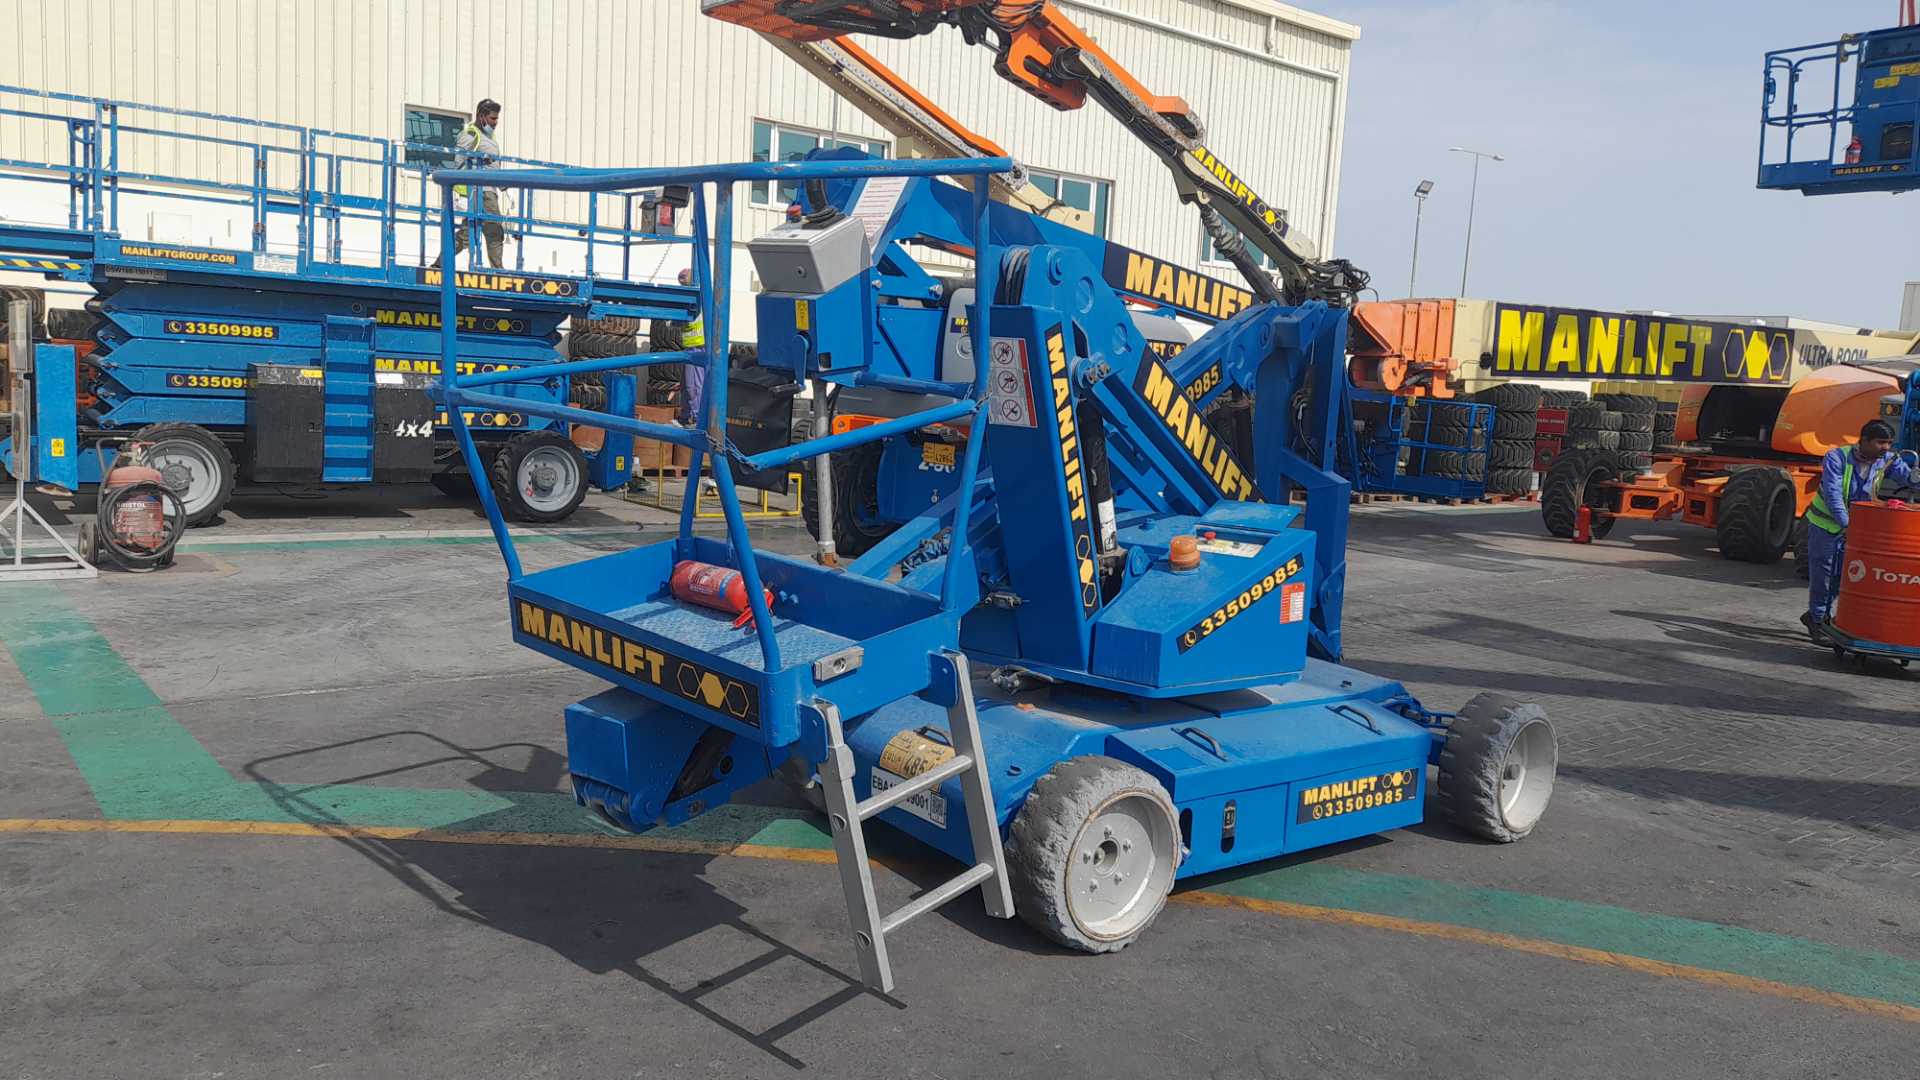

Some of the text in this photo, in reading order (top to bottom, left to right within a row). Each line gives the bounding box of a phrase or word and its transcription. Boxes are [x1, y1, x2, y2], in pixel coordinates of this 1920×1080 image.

[1191, 147, 1256, 205] MANLIFT
[122, 246, 235, 264] MANLIFTGROUP.COM
[1125, 253, 1252, 320] MANLIFT
[185, 322, 273, 338] 33509985
[376, 309, 477, 329] MANLFT
[1496, 310, 1712, 376] MANLIFT
[1799, 344, 1833, 367] ULTRA
[376, 358, 476, 375] MANLFT
[394, 420, 433, 438] 4x4
[1047, 332, 1086, 520] MANLIFT
[1144, 361, 1252, 503] MANLIFT
[1201, 558, 1298, 636] 33509985
[520, 601, 664, 685] MANLIFT
[1303, 776, 1378, 805] MANLIFT
[1325, 790, 1403, 817] 33509985
